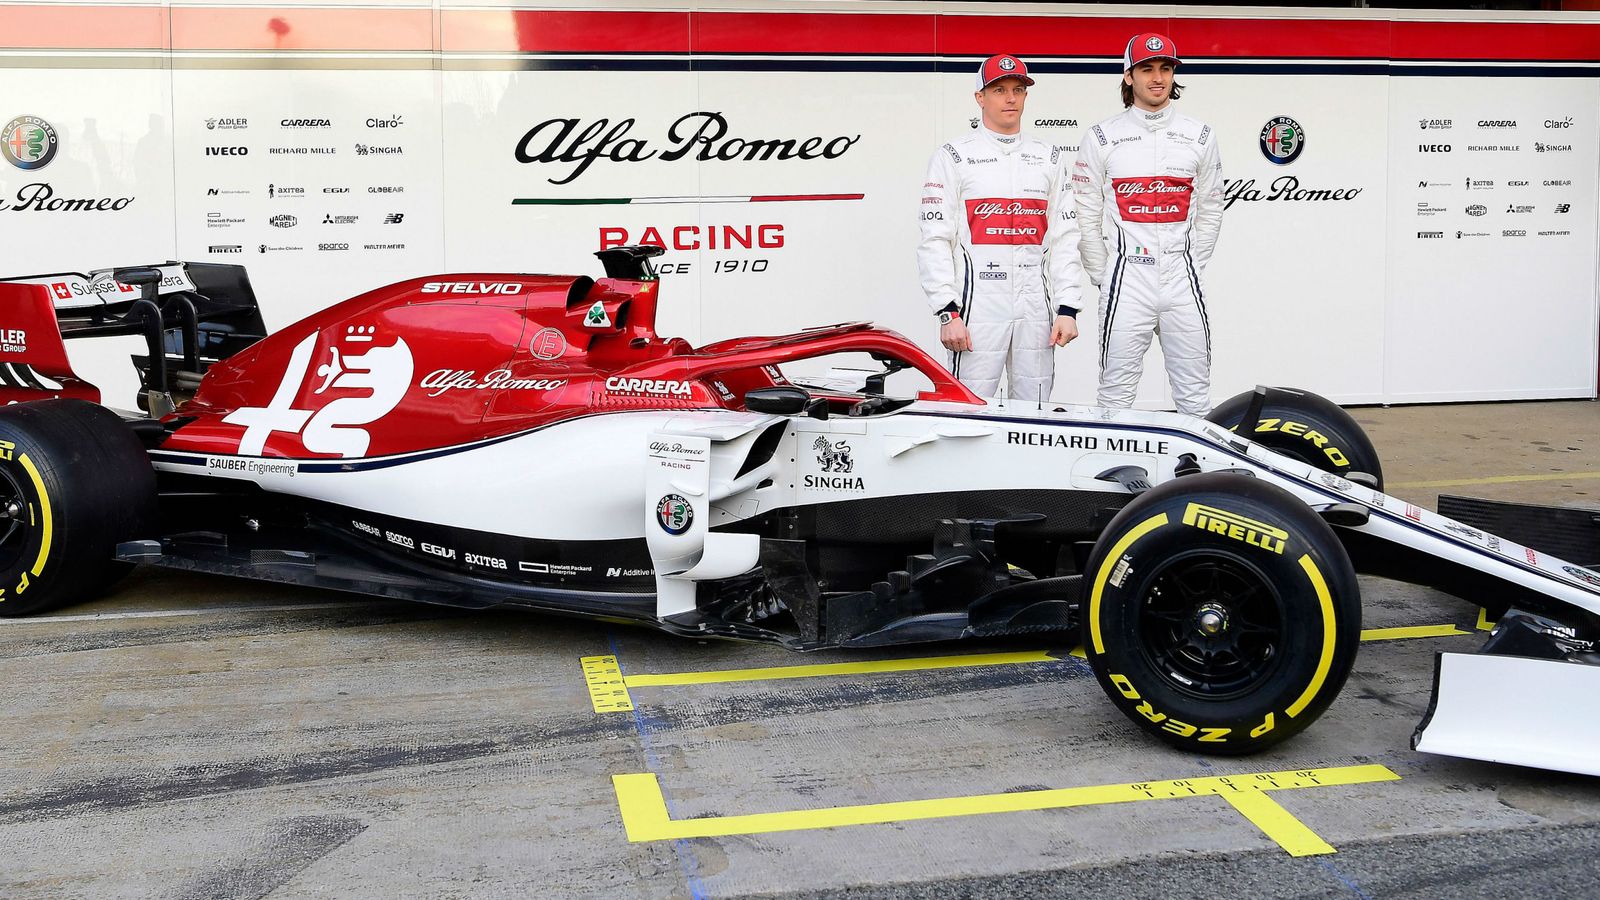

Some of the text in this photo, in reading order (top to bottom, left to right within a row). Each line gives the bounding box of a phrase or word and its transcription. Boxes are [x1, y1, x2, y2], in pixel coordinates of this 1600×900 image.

[218, 118, 248, 126] ADLER
[280, 119, 331, 127] CARRERA
[365, 118, 398, 128] Claro
[1261, 117, 1304, 142] ALFA ROMEO
[1543, 119, 1569, 129] Claro
[25, 117, 56, 143] ROMEO
[1119, 135, 1142, 143] SINGHA
[205, 146, 249, 156] IVECO
[269, 147, 308, 155] RICHARD
[369, 146, 403, 154] SINGHA
[514, 111, 861, 185] Alfa Romeo
[1418, 144, 1452, 153] IVECO
[1546, 144, 1572, 152] SINGHA
[1117, 180, 1189, 198] Alfa Romeo
[1223, 176, 1363, 212] lfa Romeo
[11, 182, 135, 212] Romeo
[974, 202, 1046, 220] Alfa Romeo
[1062, 210, 1078, 221] iLO
[599, 224, 785, 251] RACING
[985, 227, 1038, 236] STELVIO
[318, 243, 350, 251] sparco
[713, 259, 769, 274] 1910
[71, 281, 116, 296] Suisse
[421, 282, 522, 294] STELVIO
[0, 329, 26, 344] LER
[420, 368, 566, 397] Alfa Romeo
[605, 376, 692, 395] CARRERA
[649, 441, 671, 454] Alfa
[1006, 430, 1169, 455] RICHARD MILLE
[1254, 417, 1351, 468] ZERO
[209, 458, 295, 476] SAUBER Engineering
[661, 462, 692, 470] RACING
[804, 474, 865, 490] SINGHA
[1182, 502, 1289, 555] PIRELLI
[386, 530, 415, 549] sparco
[464, 552, 508, 570] axitea
[1109, 673, 1232, 743] ZERO
